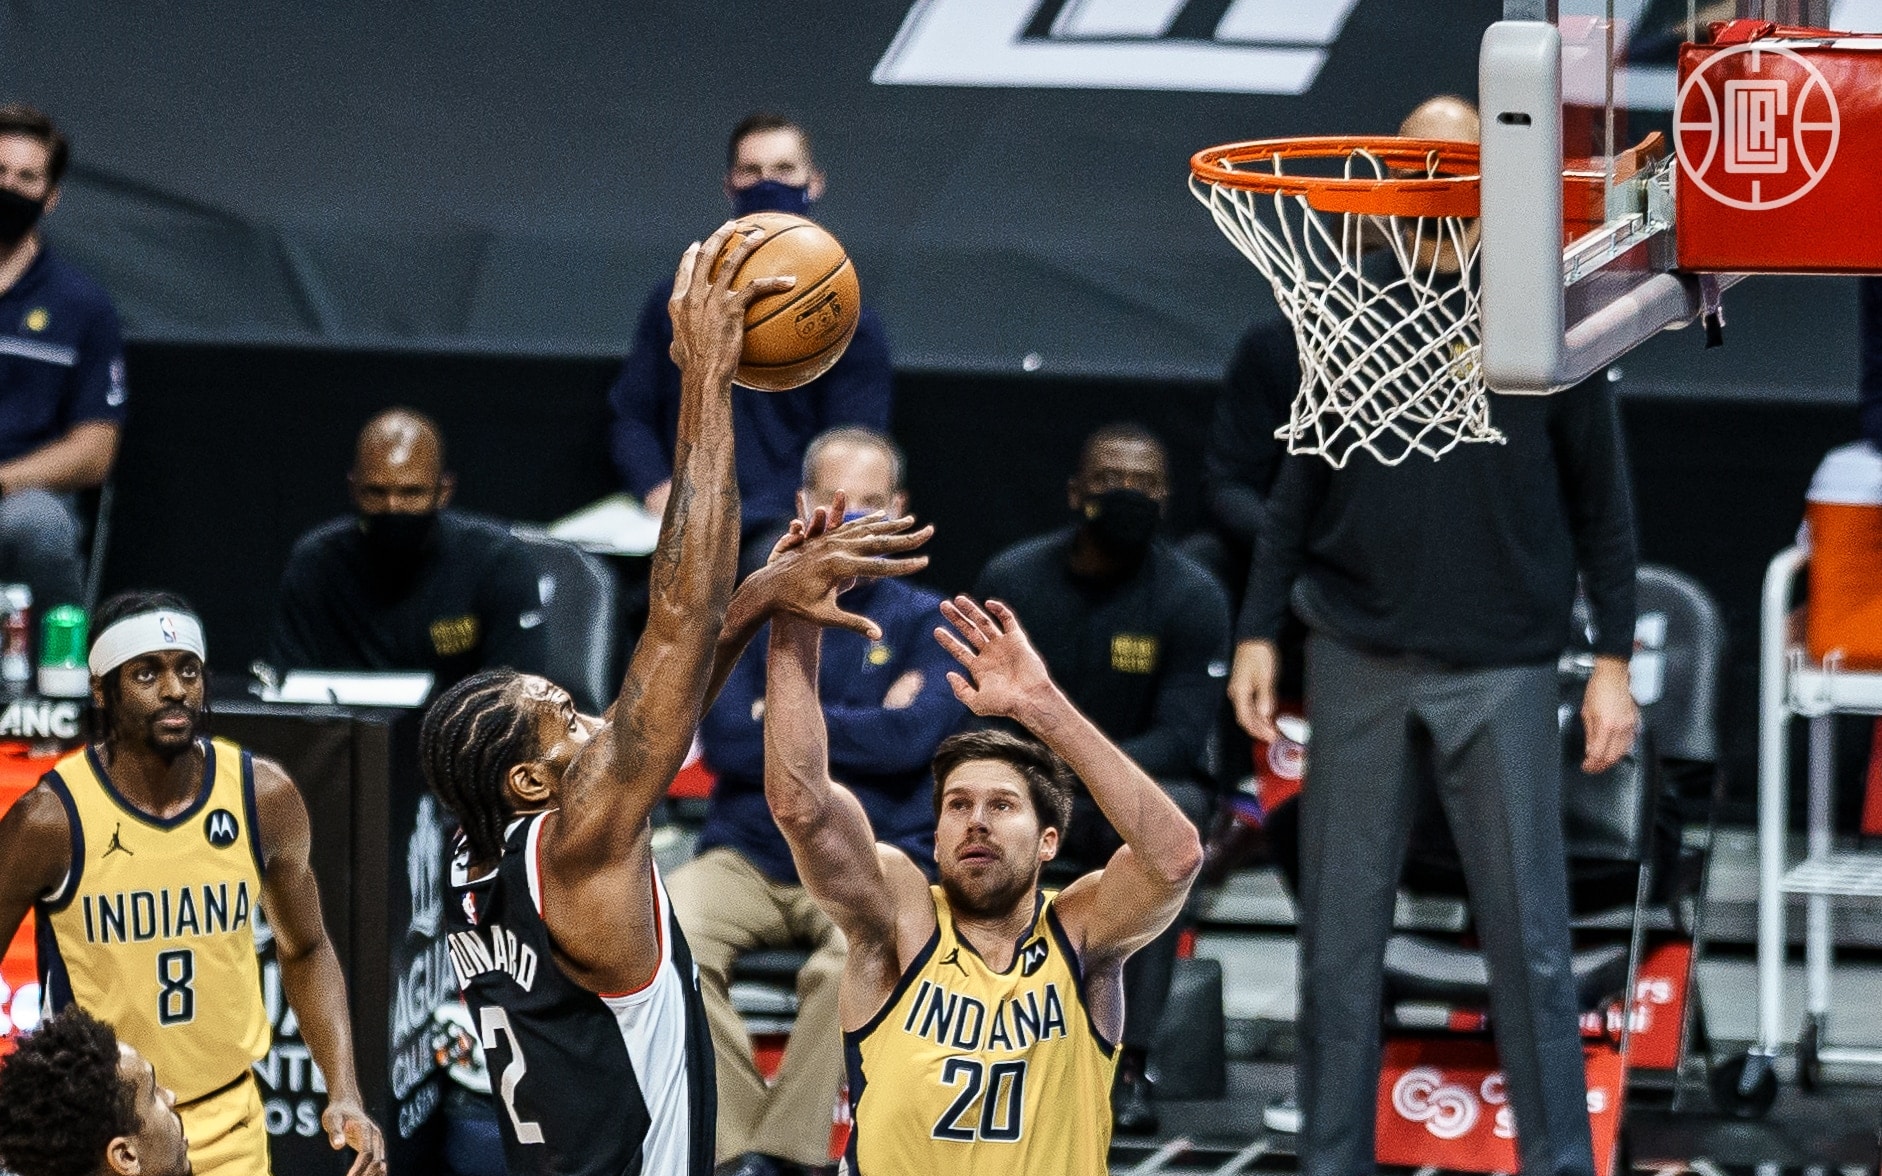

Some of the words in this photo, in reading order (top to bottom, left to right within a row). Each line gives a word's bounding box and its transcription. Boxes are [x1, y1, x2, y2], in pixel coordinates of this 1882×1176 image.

[82, 880, 252, 945] INDIANA
[156, 948, 195, 1027] 8
[903, 979, 1068, 1054] INDANA
[478, 1006, 546, 1145] 2
[930, 1056, 1028, 1144] 20
